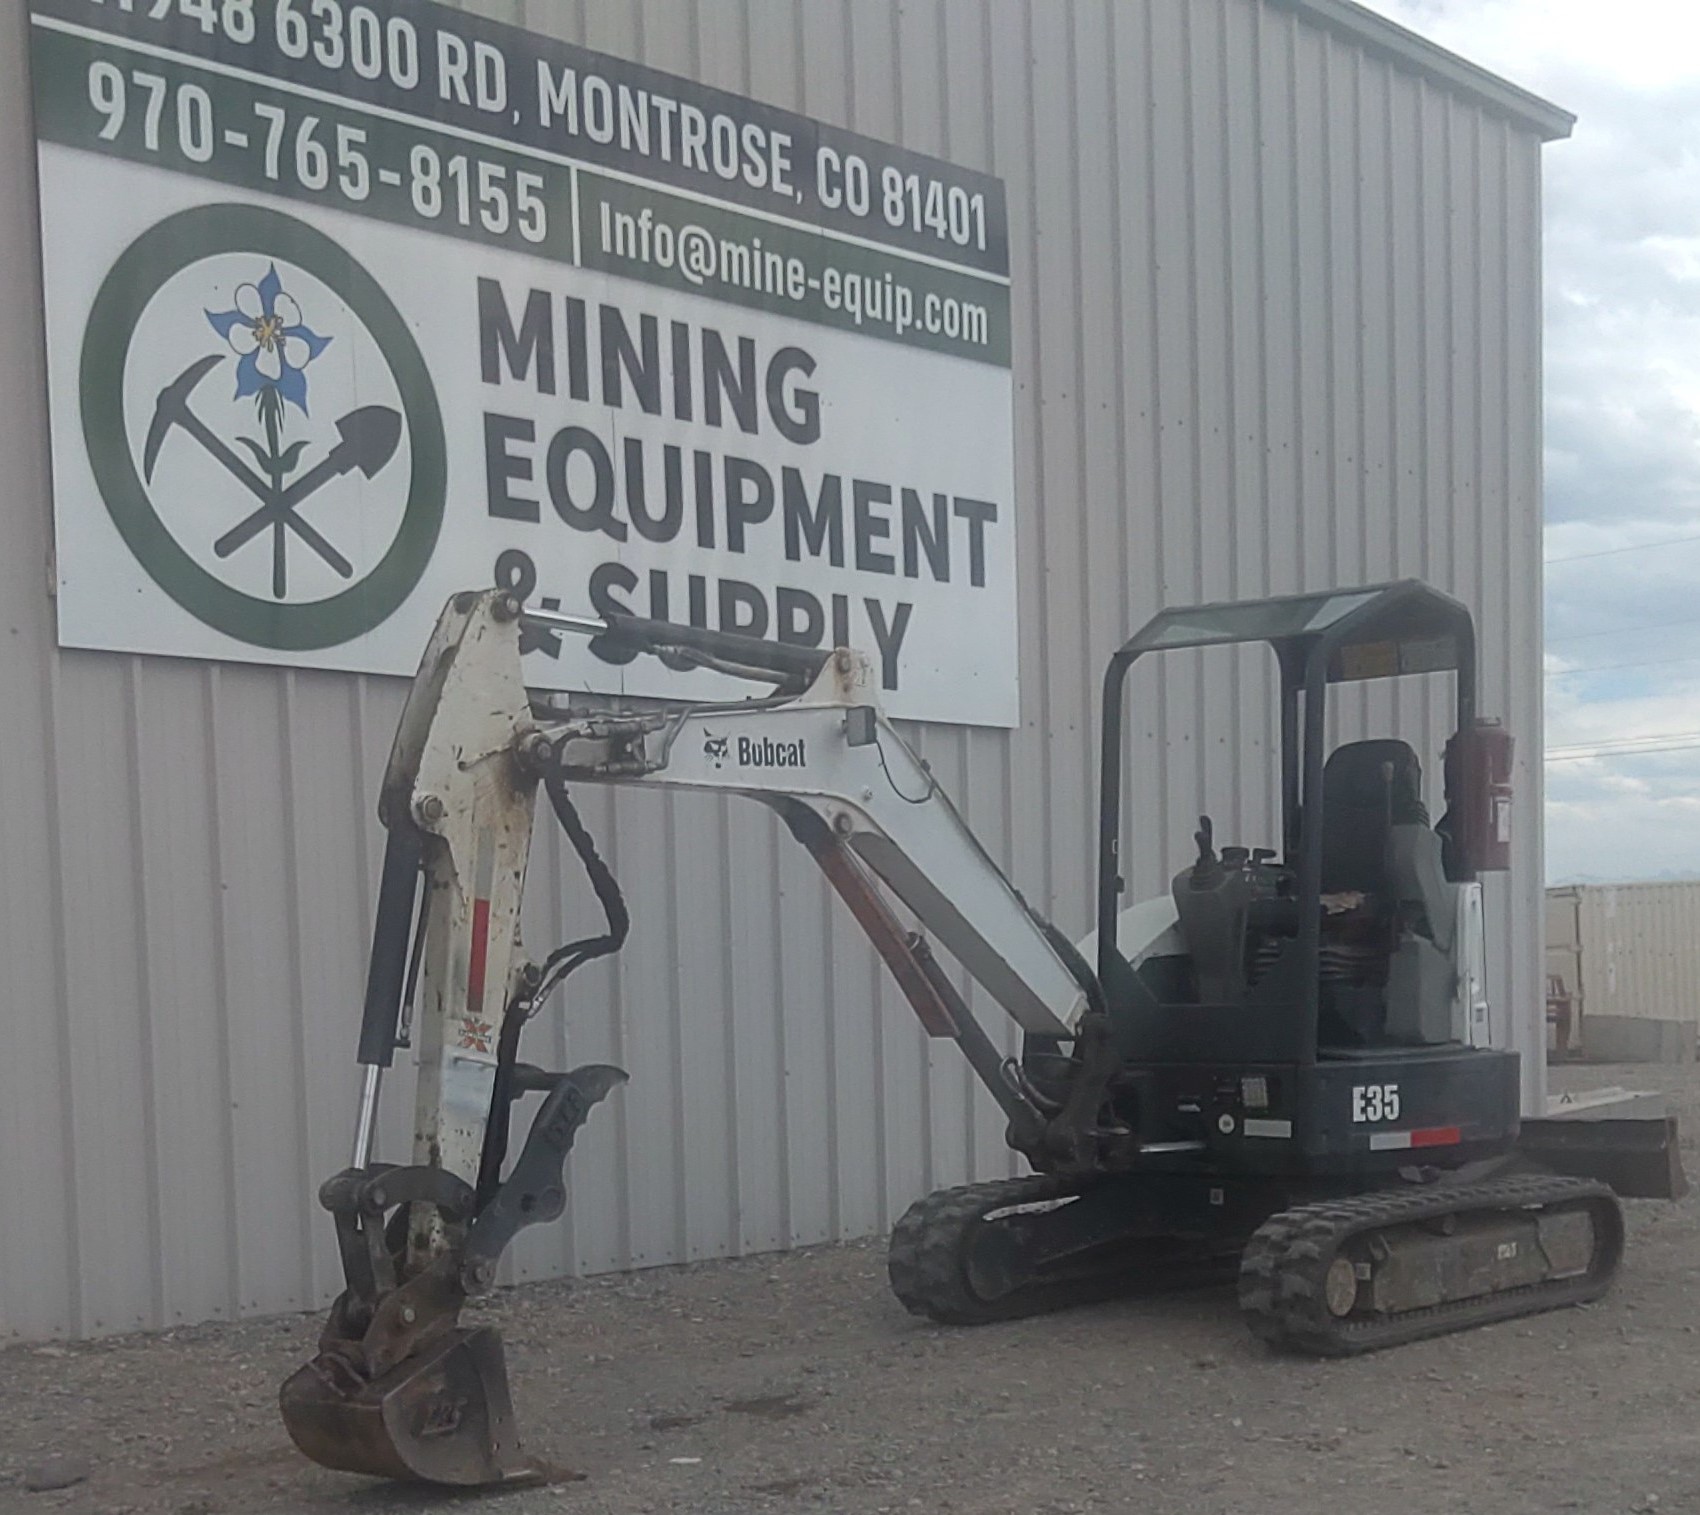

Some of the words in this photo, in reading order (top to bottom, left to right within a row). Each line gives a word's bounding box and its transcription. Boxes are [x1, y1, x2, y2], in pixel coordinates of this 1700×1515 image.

[88, 60, 548, 243] 970-765-8155
[275, 0, 419, 90] 6300
[437, 30, 519, 125] RD,
[537, 59, 803, 204] MONTROSE,
[817, 146, 870, 217] CO
[882, 166, 987, 251] 81401
[600, 201, 989, 345] Info@mine-equip.com
[477, 276, 821, 445] MINING
[483, 411, 998, 588] EQUIPMENT
[738, 736, 806, 767] Bobcat
[1352, 1085, 1400, 1123] E35
